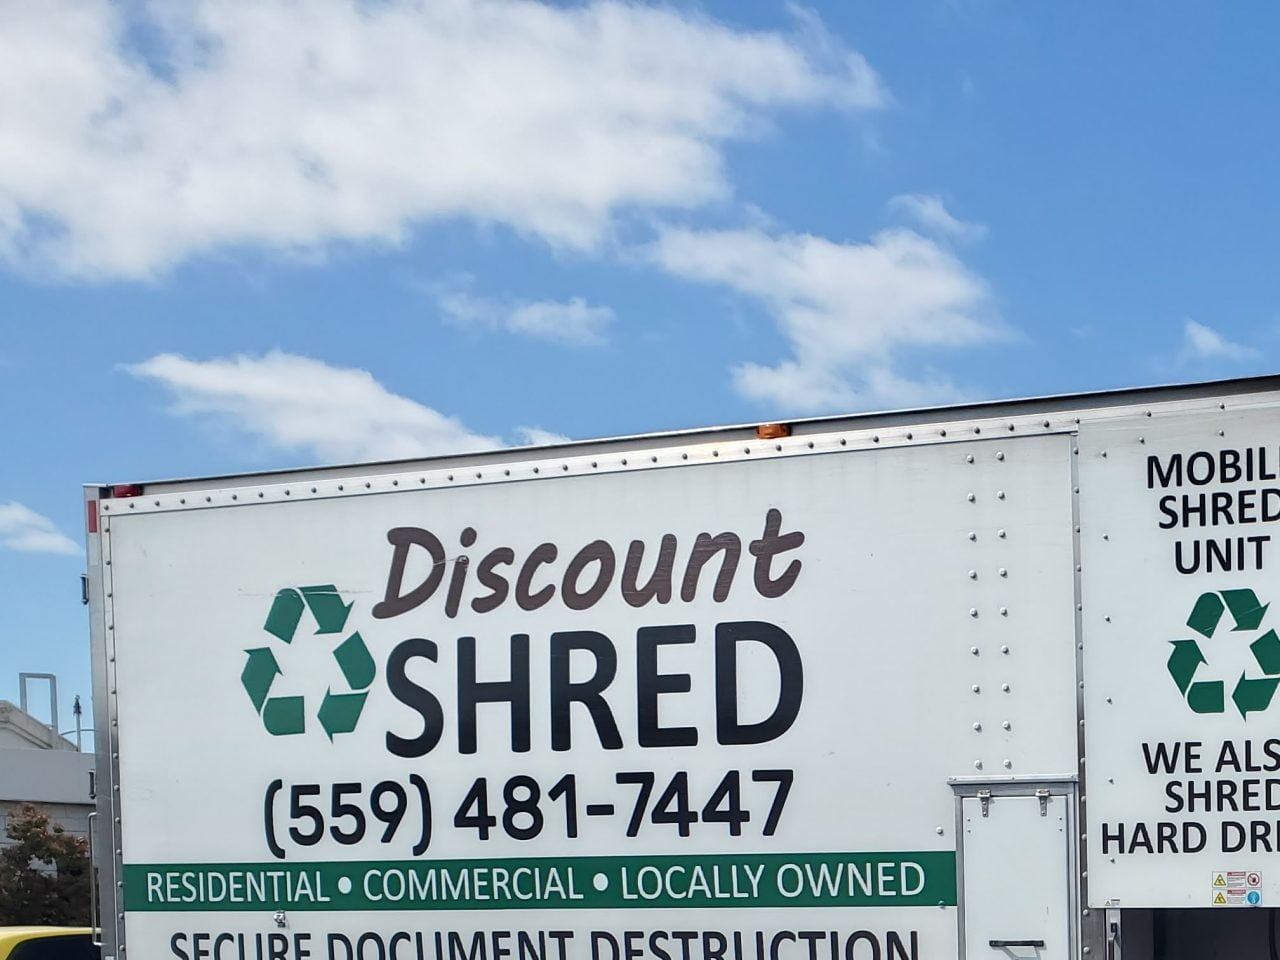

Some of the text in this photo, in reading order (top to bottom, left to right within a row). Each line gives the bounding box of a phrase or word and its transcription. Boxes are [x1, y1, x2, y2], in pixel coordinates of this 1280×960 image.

[371, 507, 806, 620] Discount
[1175, 535, 1271, 575] UNIT
[385, 620, 804, 759] SHRED
[1141, 741, 1203, 775] WE
[264, 769, 794, 860] (559) 481-7447
[1101, 821, 1207, 855] HARD
[147, 870, 331, 902] RESIDENTIAL
[363, 867, 584, 901] COMMERCIAL
[621, 864, 765, 900] LOCALLY
[776, 861, 925, 898] OWNED
